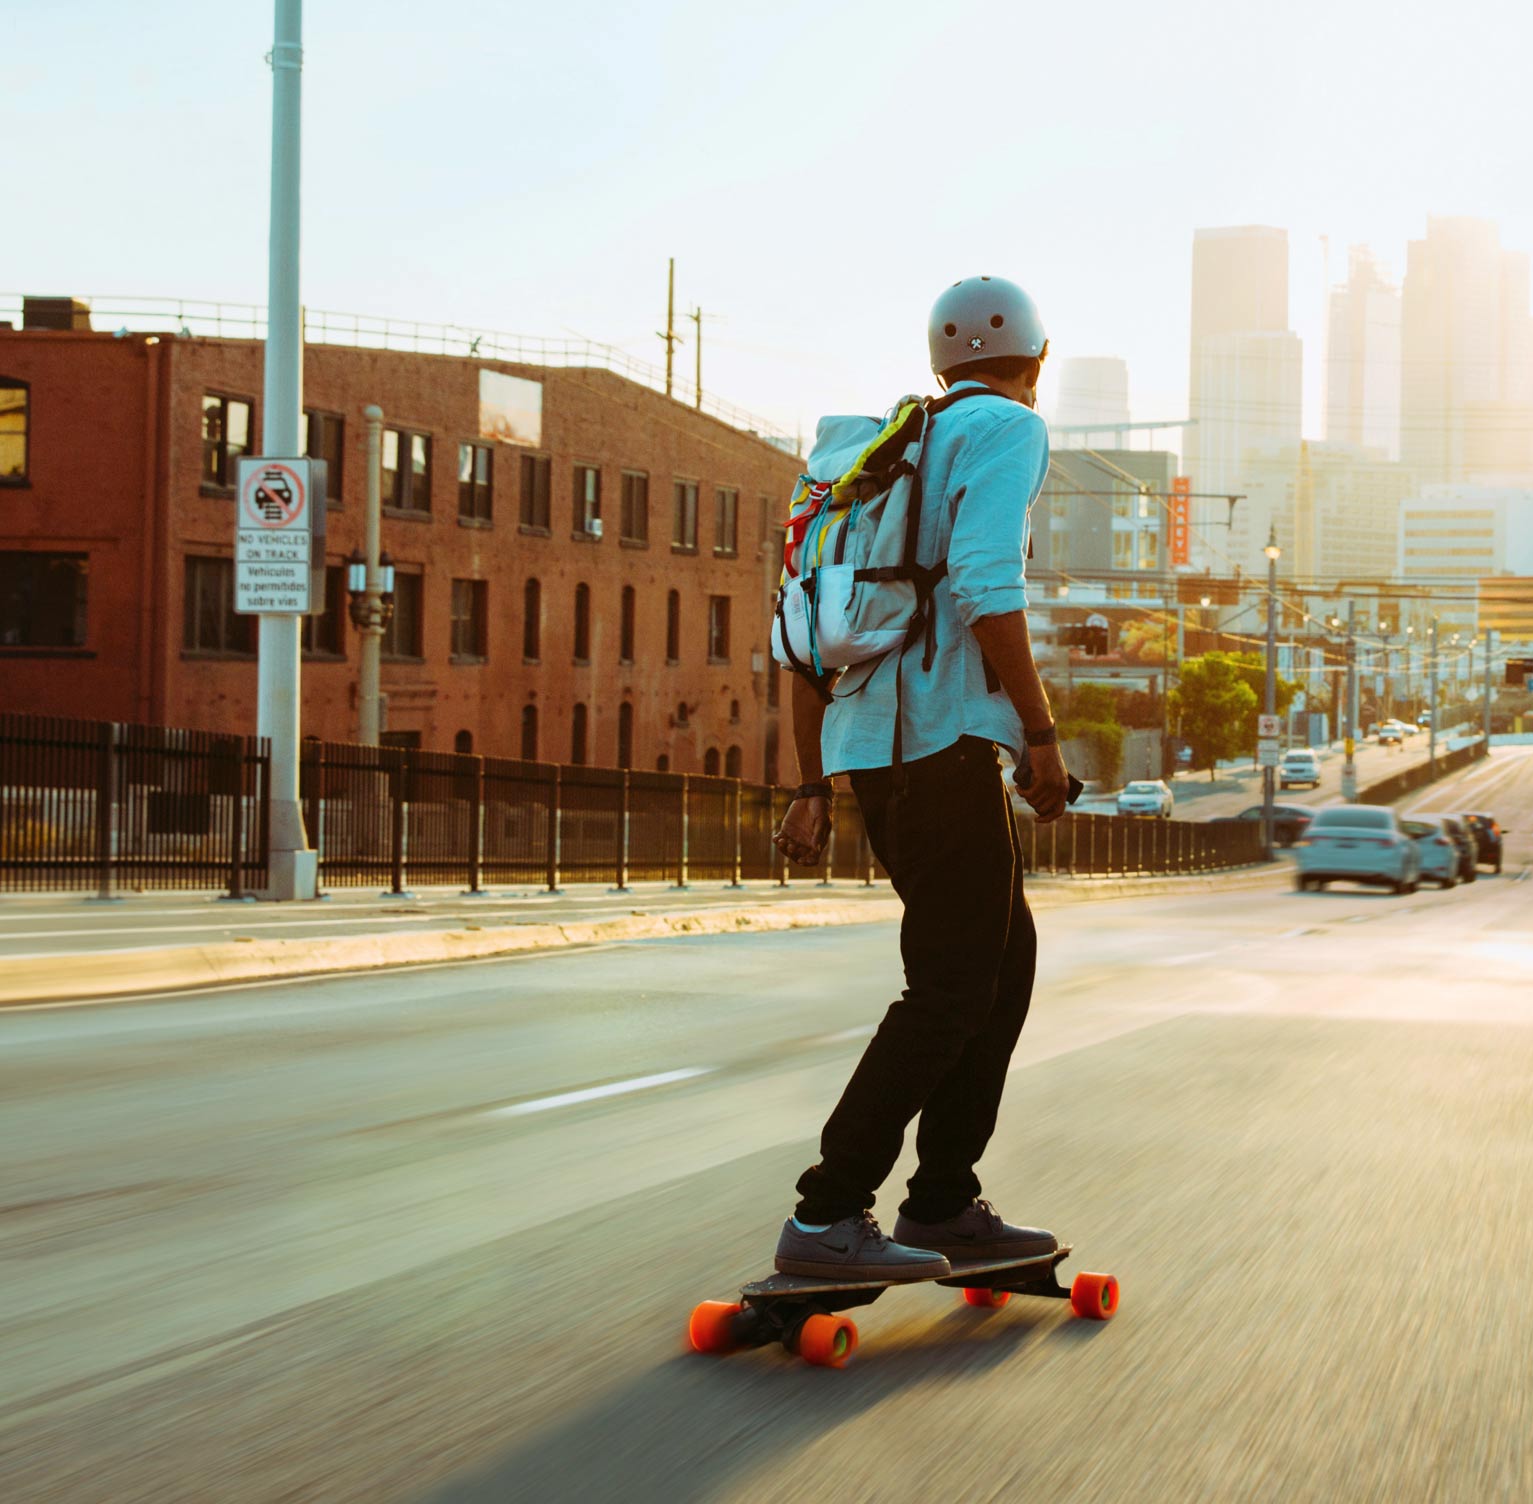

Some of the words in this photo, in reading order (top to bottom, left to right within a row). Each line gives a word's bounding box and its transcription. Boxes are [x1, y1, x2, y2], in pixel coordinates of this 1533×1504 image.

[240, 534, 254, 544] NO
[258, 535, 307, 545] VEHICLES
[247, 549, 261, 559] ON
[265, 549, 298, 560] TRACK
[240, 583, 251, 591] no
[254, 581, 307, 593] permitidos
[247, 596, 275, 606] sobre
